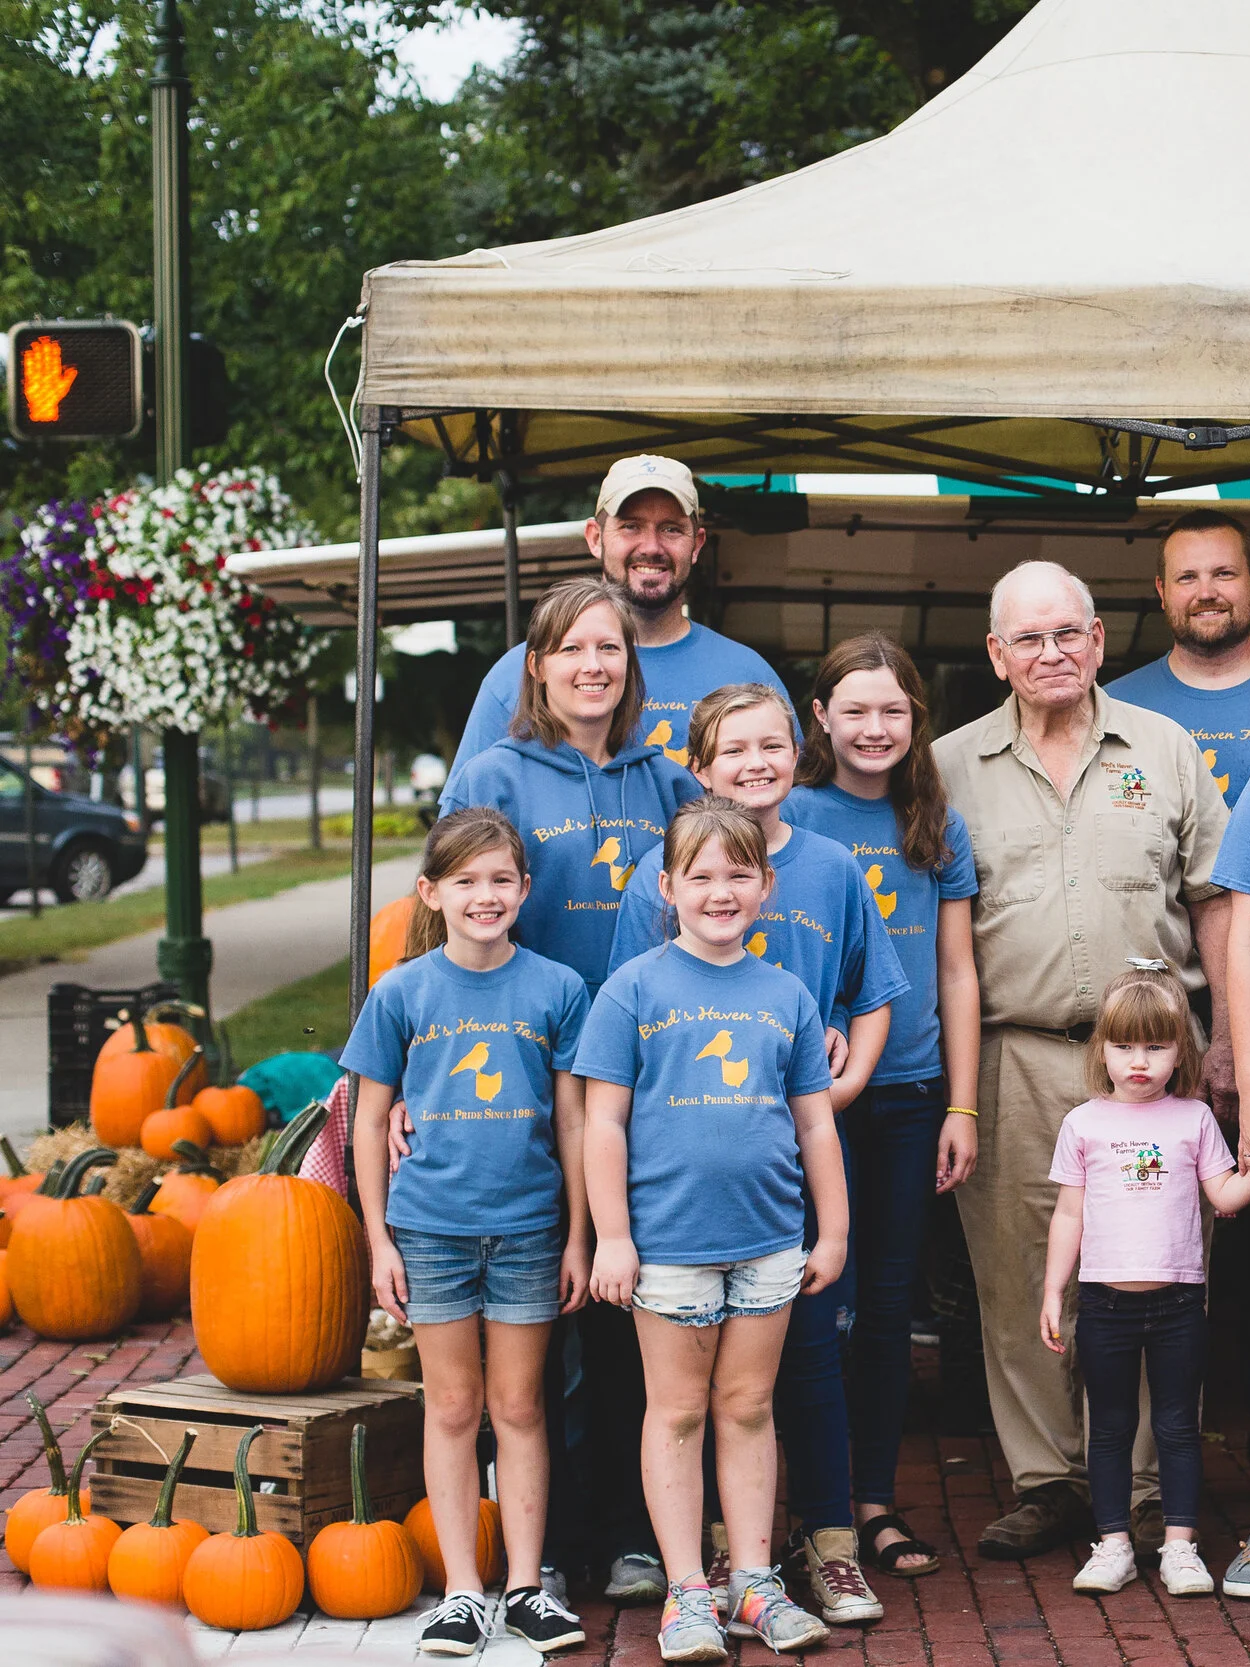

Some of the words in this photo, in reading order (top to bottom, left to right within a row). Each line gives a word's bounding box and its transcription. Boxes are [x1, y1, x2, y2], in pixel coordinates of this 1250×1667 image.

[641, 696, 688, 712] Haven
[1190, 728, 1235, 740] Haven
[532, 818, 587, 843] Bird's
[639, 819, 665, 837] Far
[852, 841, 900, 857] Haven
[756, 911, 786, 922] ven
[638, 1009, 694, 1041] Bird's
[697, 1005, 752, 1021] Haven
[409, 1024, 452, 1050] ird's
[456, 1017, 509, 1034] Haven
